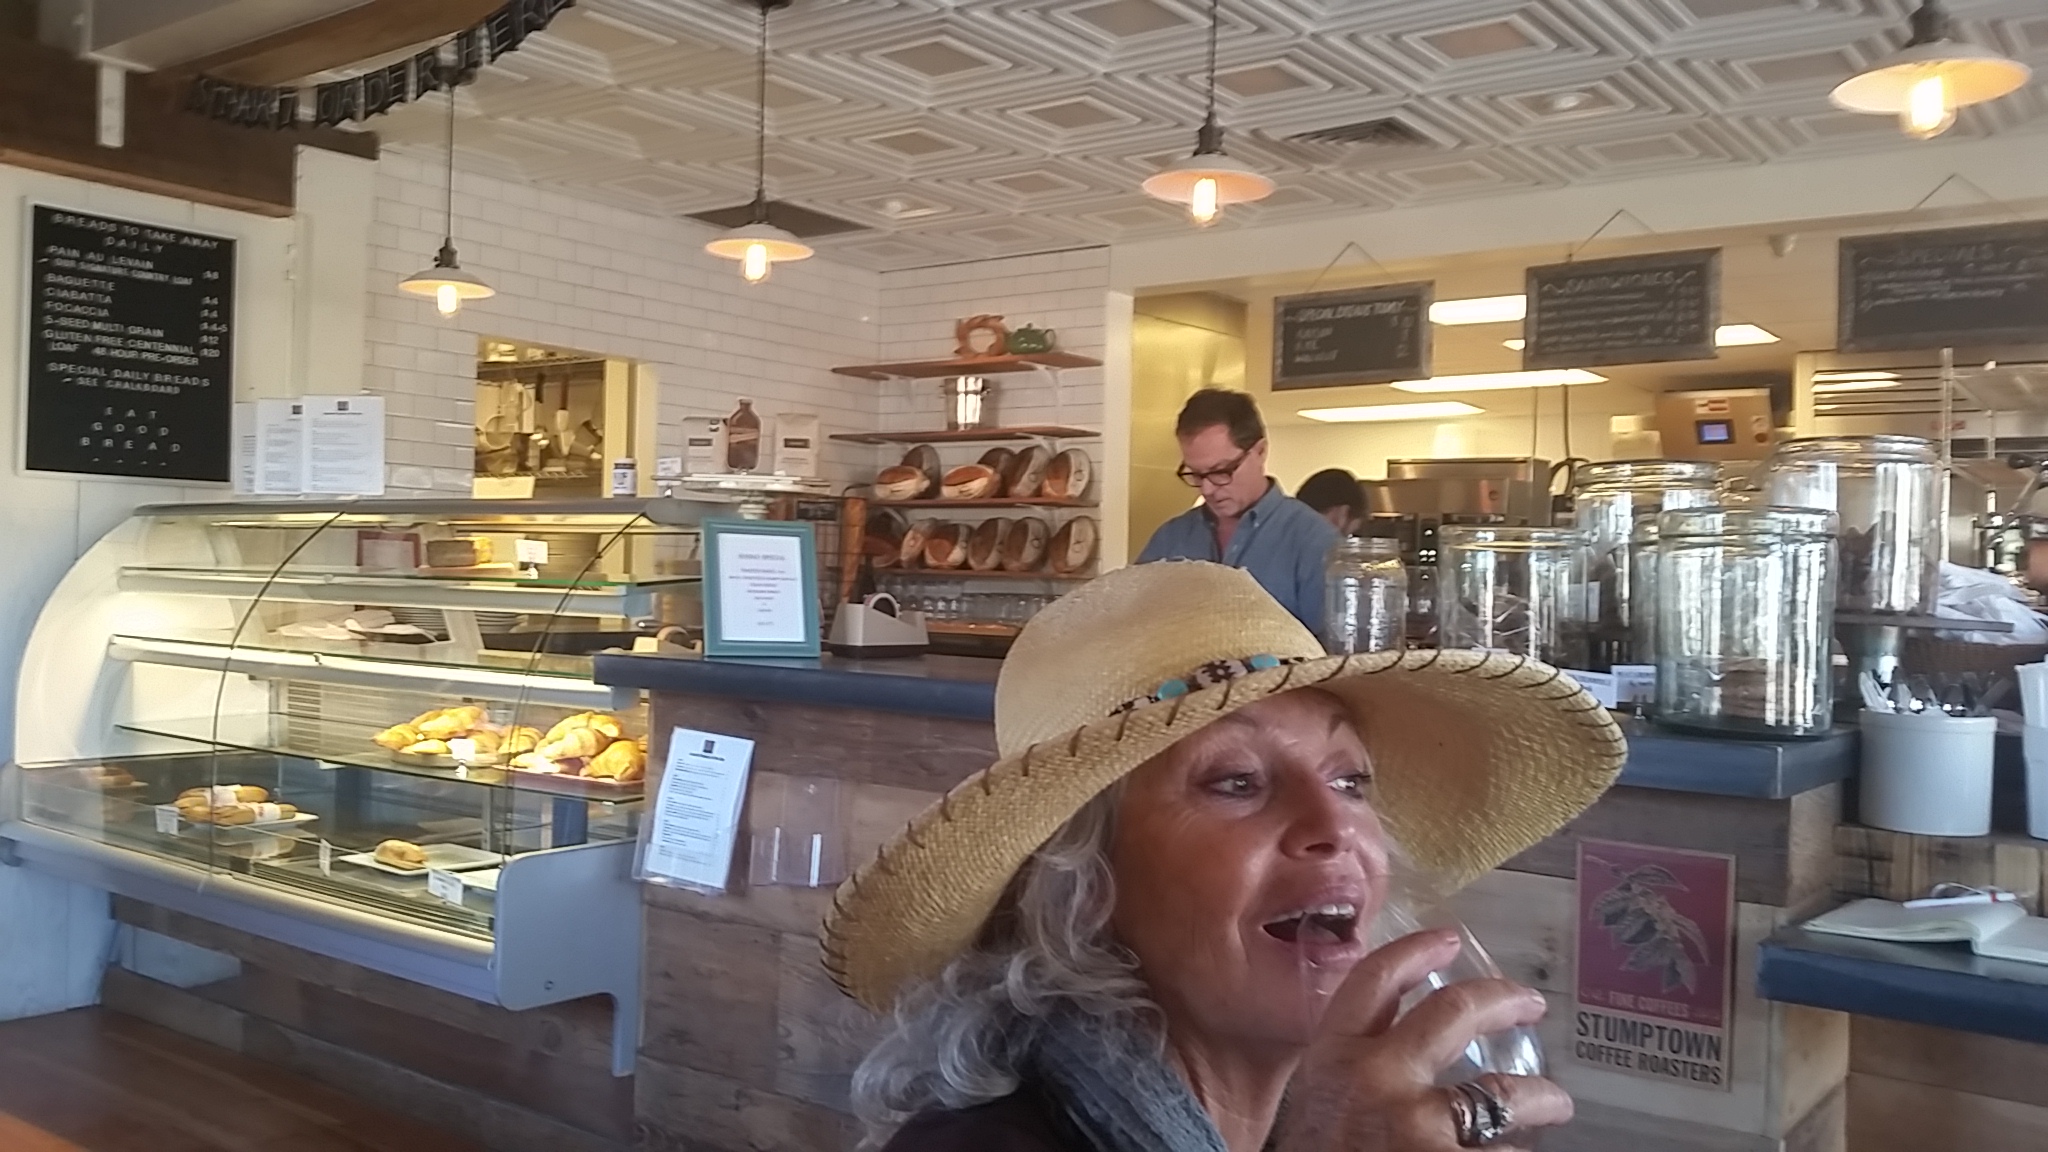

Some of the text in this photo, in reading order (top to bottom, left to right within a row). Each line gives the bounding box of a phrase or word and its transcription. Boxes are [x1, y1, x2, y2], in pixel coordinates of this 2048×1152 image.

[320, 54, 439, 121] ORDER
[52, 213, 219, 249] BREADS TO TAKE AWAY
[104, 236, 163, 253] DAILY
[48, 245, 81, 259] PAIN
[86, 251, 105, 263] AU
[110, 255, 154, 270] LEVAIN
[46, 272, 116, 292] BAGUETTE
[45, 286, 113, 304] CIABATTA
[45, 300, 110, 317] FOCACCIA
[91, 320, 125, 333] MULTI
[127, 325, 164, 338] GRAIN
[43, 328, 92, 343] GLUTEN
[95, 335, 124, 347] FREE
[127, 339, 195, 355] CENTENNIAL
[50, 341, 79, 352] LOAF
[110, 348, 138, 360] HOUR
[140, 351, 199, 366] PRE-ORDER
[48, 362, 210, 387] SPECIAL DAILY BREADS
[77, 376, 180, 395] SEE CHALKBOARD
[104, 406, 157, 420] EAT
[91, 421, 170, 437] GOOD
[79, 436, 181, 453] BREAD
[1576, 1011, 1722, 1062] STUMPTOWN
[1576, 1040, 1722, 1085] COFFEE ROASTERS
